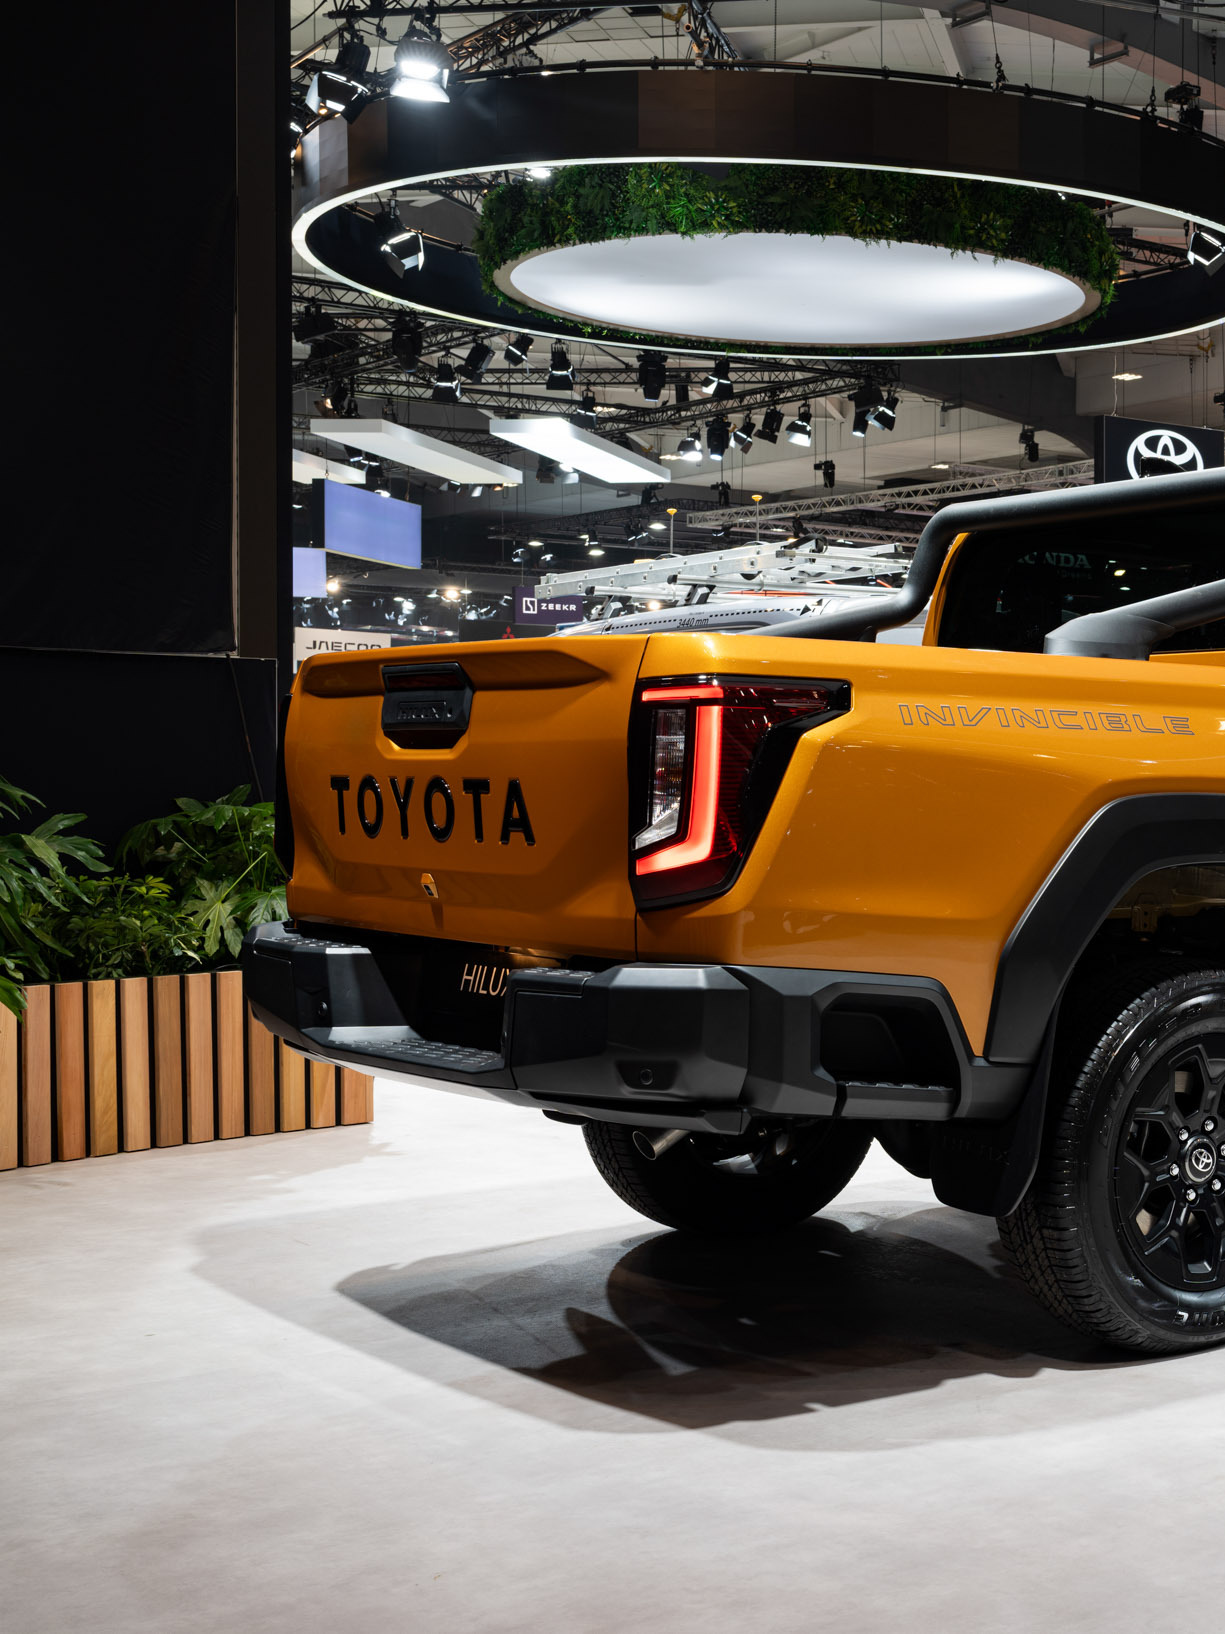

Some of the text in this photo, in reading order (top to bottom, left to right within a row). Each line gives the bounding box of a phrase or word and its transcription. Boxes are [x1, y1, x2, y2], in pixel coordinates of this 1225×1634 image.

[541, 603, 577, 611] ZEEKR
[898, 704, 1195, 736] INVINCIBLE
[330, 774, 536, 846] TOYOTA
